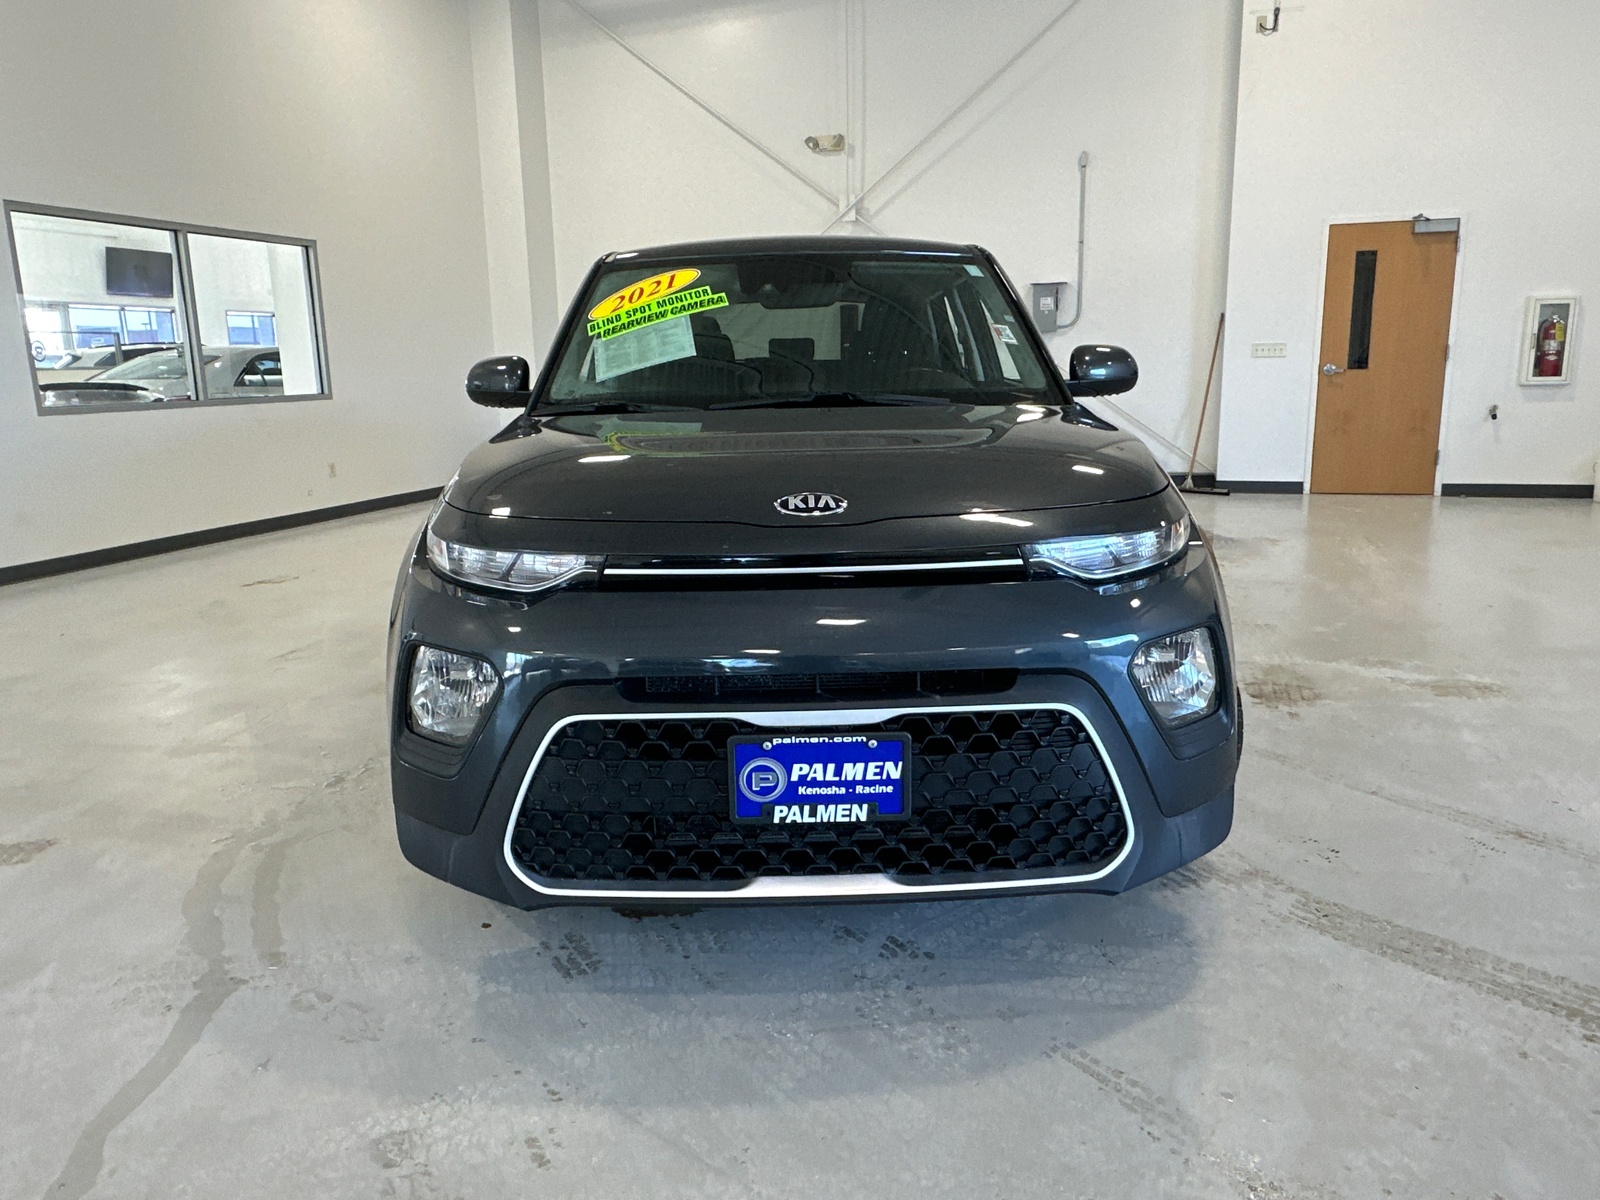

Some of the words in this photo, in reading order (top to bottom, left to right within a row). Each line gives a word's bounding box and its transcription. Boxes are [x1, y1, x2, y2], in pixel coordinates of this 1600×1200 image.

[610, 274, 676, 313] 2021
[589, 313, 622, 333] BLIND
[625, 303, 652, 319] SPOT
[656, 288, 710, 310] MONITOR
[603, 309, 669, 338] REARVIEW
[670, 295, 726, 315] CAMERA
[787, 494, 836, 509] KIA
[772, 736, 867, 745] palmen.com
[790, 761, 903, 782] PALMEN
[798, 786, 846, 795] Kenosha
[855, 784, 894, 795] Racine
[773, 803, 868, 824] PALMEN
